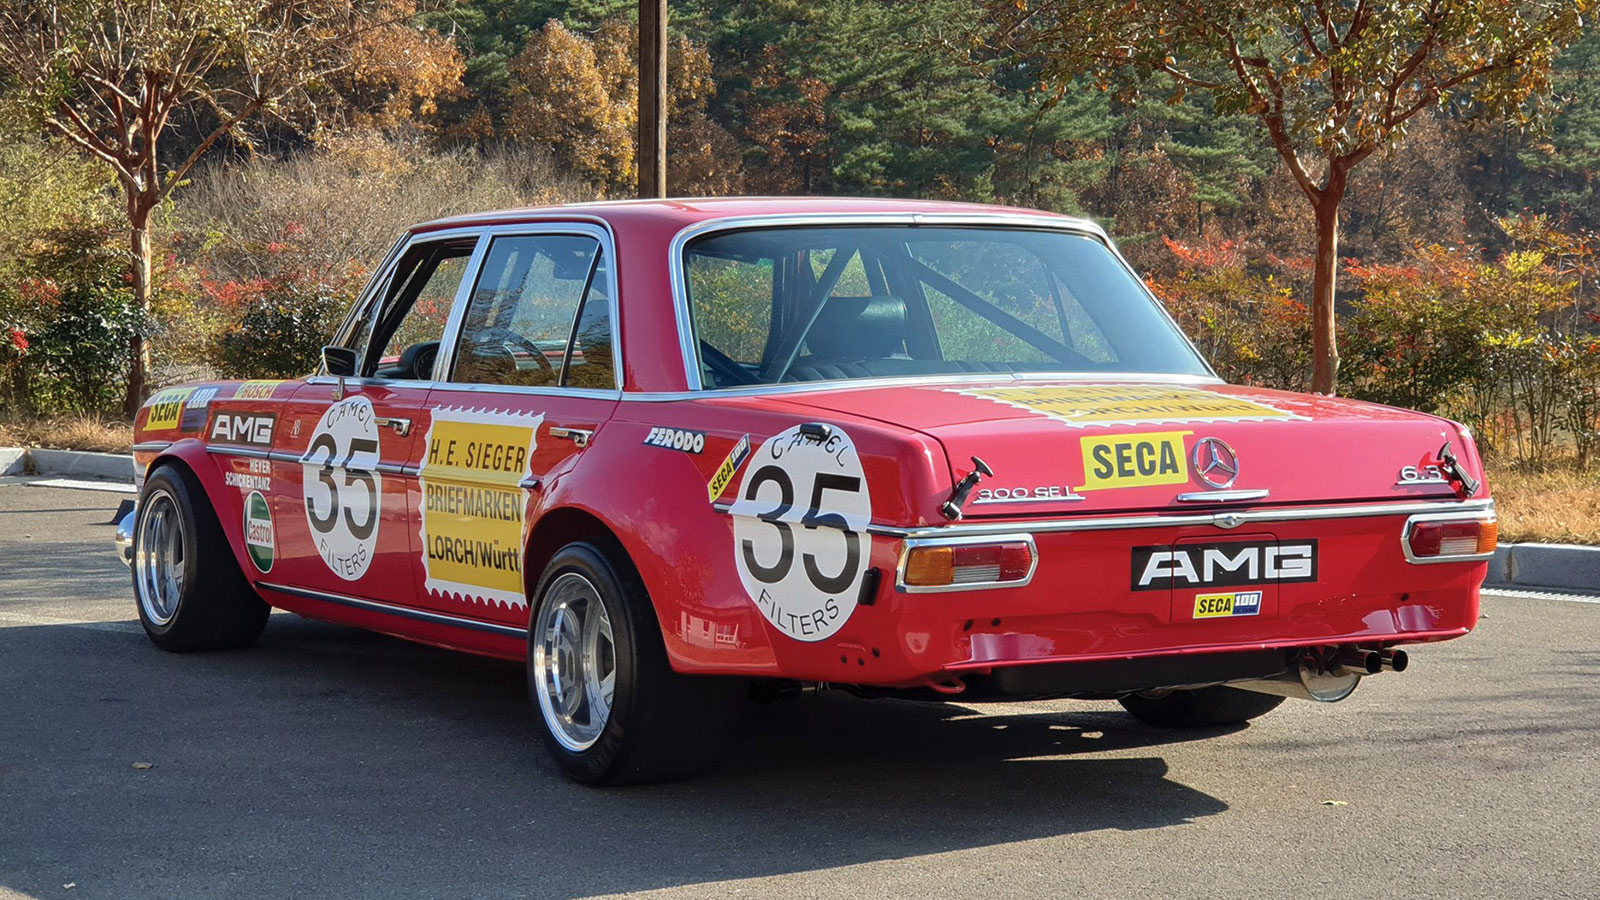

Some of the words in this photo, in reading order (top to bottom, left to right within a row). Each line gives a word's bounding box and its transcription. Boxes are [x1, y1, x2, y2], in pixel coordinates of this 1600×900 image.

[241, 384, 276, 398] BOSCH
[211, 414, 274, 444] AMG
[326, 401, 372, 432] CAMEL
[643, 427, 704, 453] FERODO
[771, 431, 849, 467] CAEL
[249, 458, 270, 473] HEYER
[466, 441, 526, 473] SIEGER
[712, 462, 733, 496] SECA
[730, 438, 748, 464] 100
[1093, 440, 1180, 480] SECA
[225, 472, 271, 491] SCHICKENTANZ
[306, 433, 379, 541] 35
[978, 488, 1028, 500] 300
[427, 484, 521, 522] BRIEFMARKEN
[248, 520, 272, 543] Castrol
[742, 465, 861, 594] 35
[319, 538, 367, 576] FILTERS
[1138, 545, 1313, 586] AMG
[758, 588, 839, 635] FILTERS
[1198, 598, 1231, 613] SECA
[1234, 594, 1259, 606] 100
